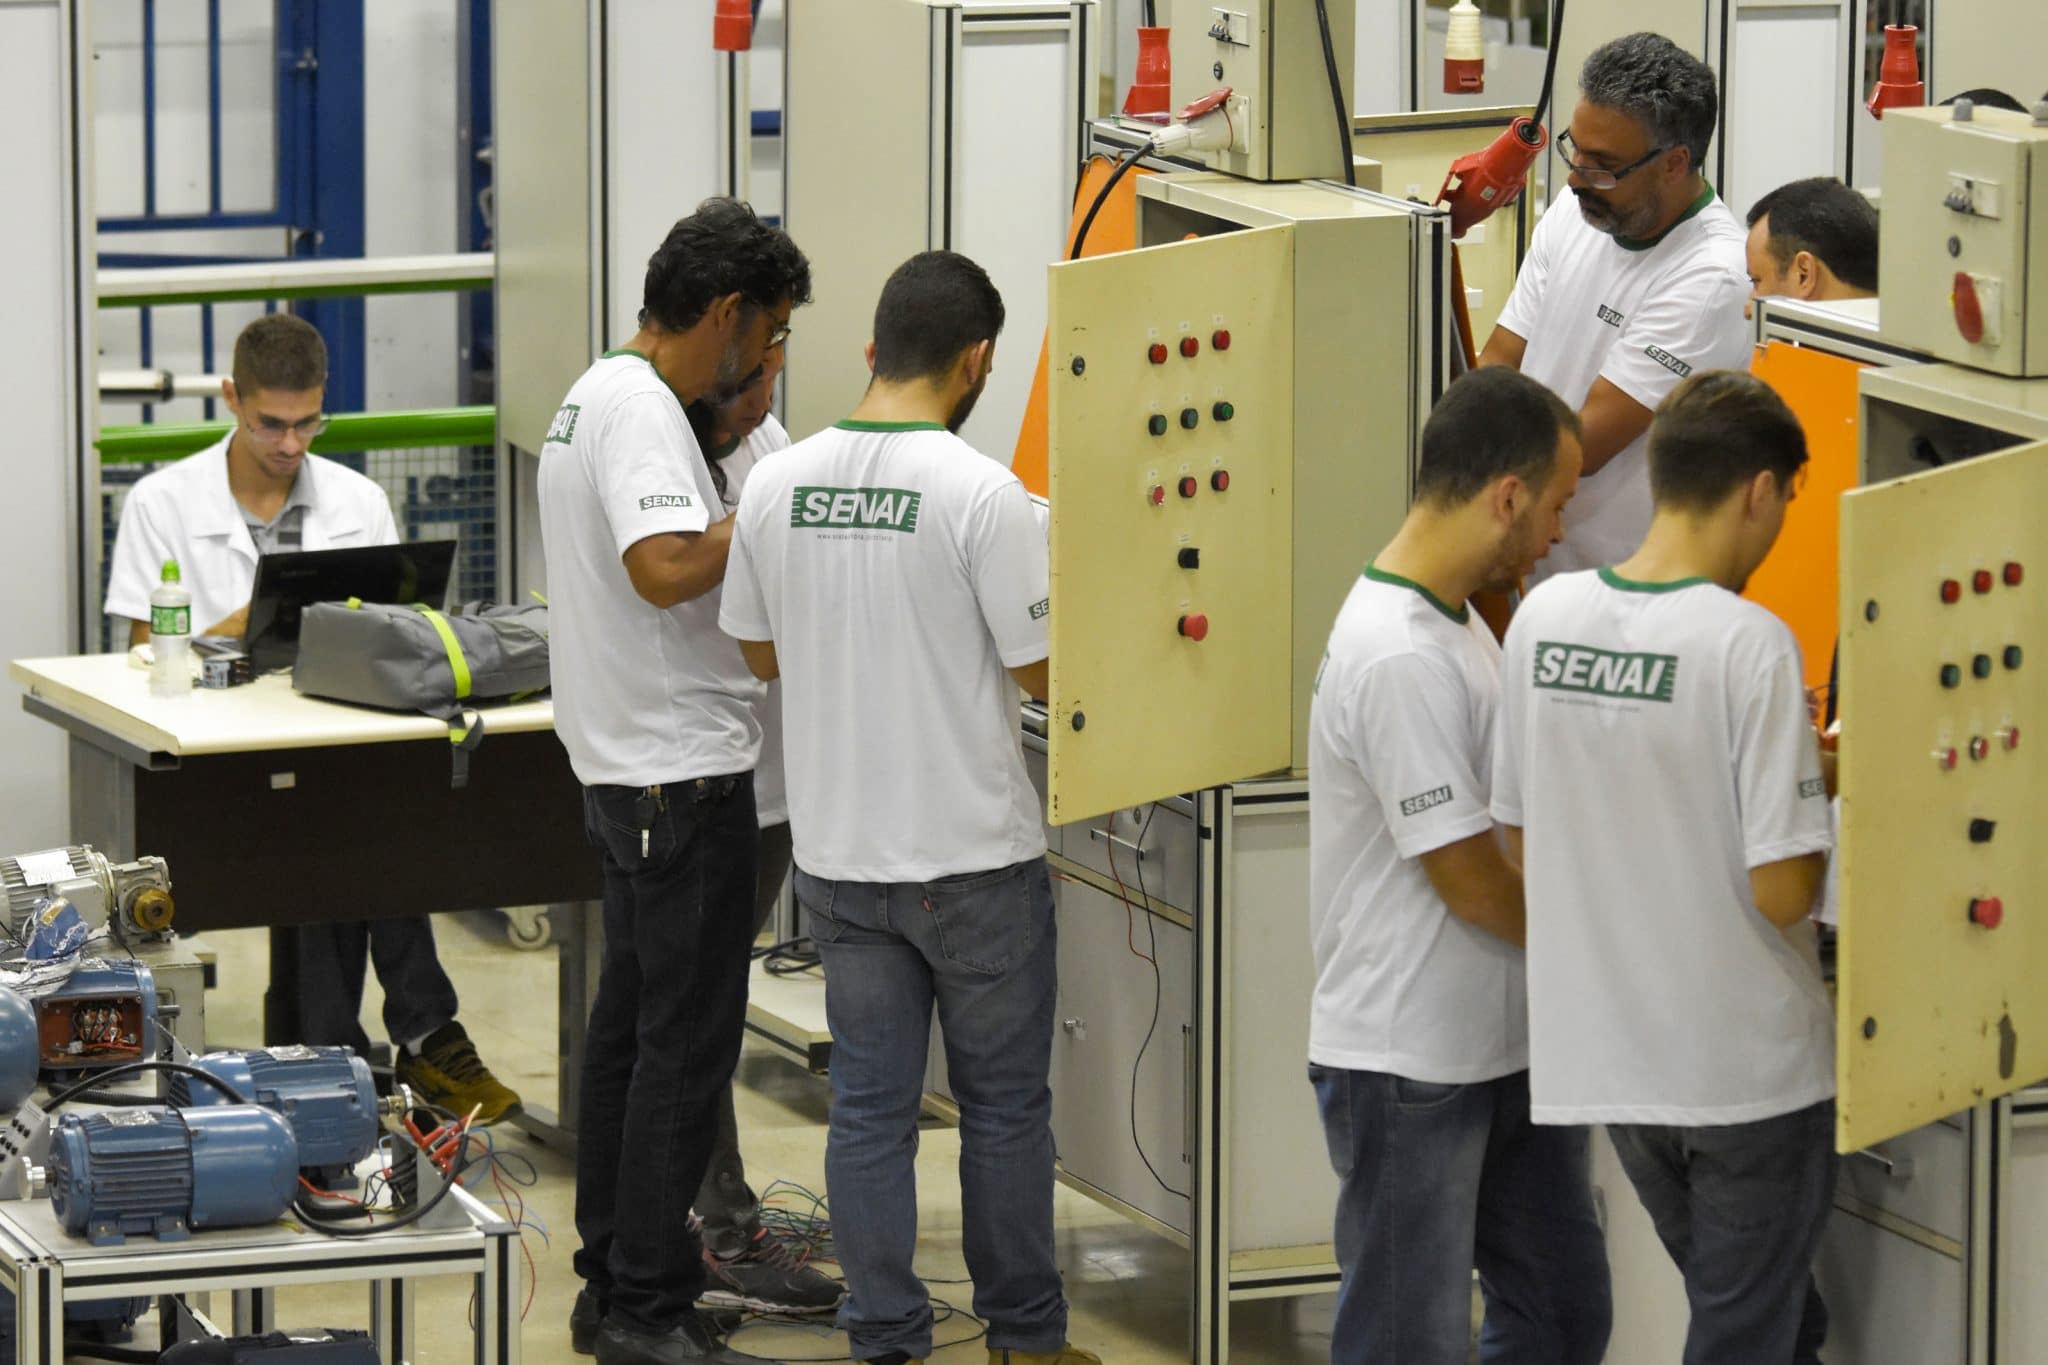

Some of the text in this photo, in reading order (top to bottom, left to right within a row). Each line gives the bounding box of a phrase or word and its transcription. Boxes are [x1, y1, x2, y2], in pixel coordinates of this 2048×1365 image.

[1647, 346, 1689, 376] SENAI
[643, 496, 688, 508] SENAI
[802, 491, 912, 526] SENAI
[1538, 647, 1667, 695] SENAI
[1405, 787, 1449, 814] SENAI
